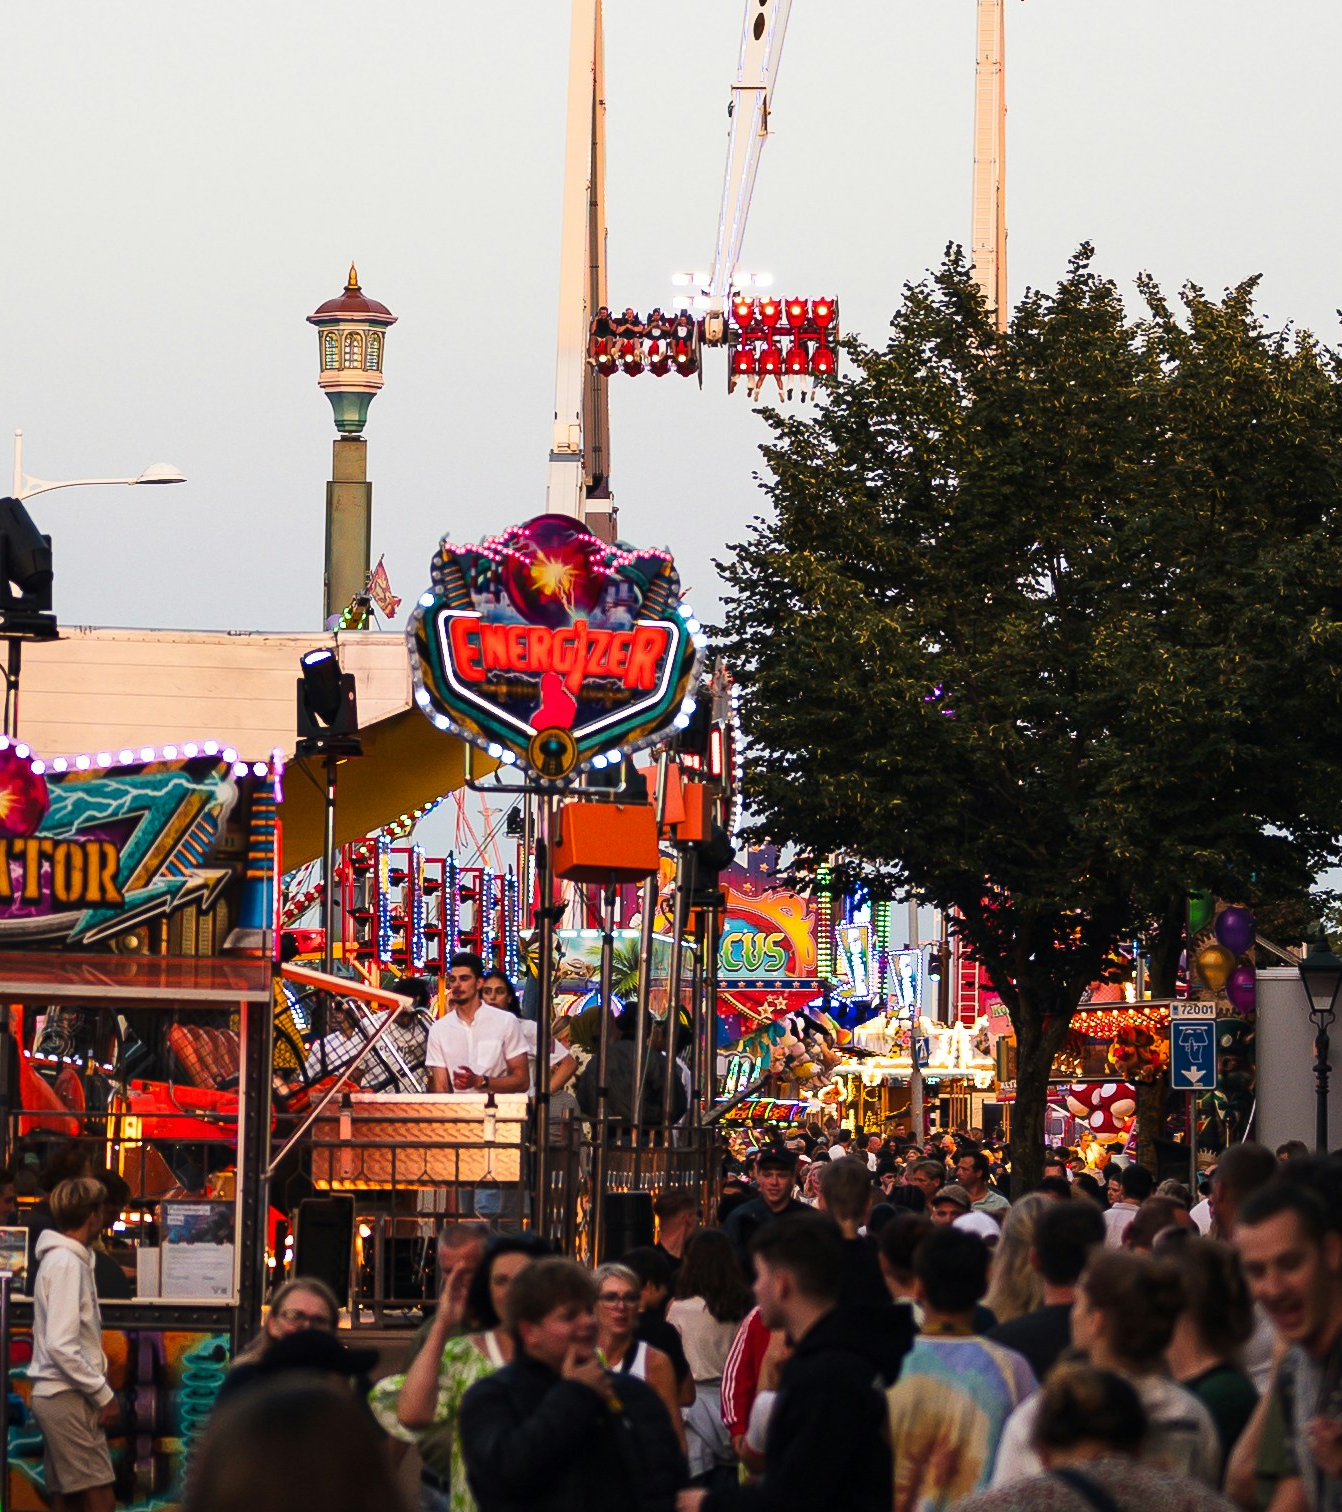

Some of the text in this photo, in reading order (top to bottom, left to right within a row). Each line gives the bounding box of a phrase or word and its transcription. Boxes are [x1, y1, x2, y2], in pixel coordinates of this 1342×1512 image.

[449, 617, 668, 695] ENERGIZER
[717, 932, 786, 971] CUS
[1180, 1004, 1214, 1015] 72001
